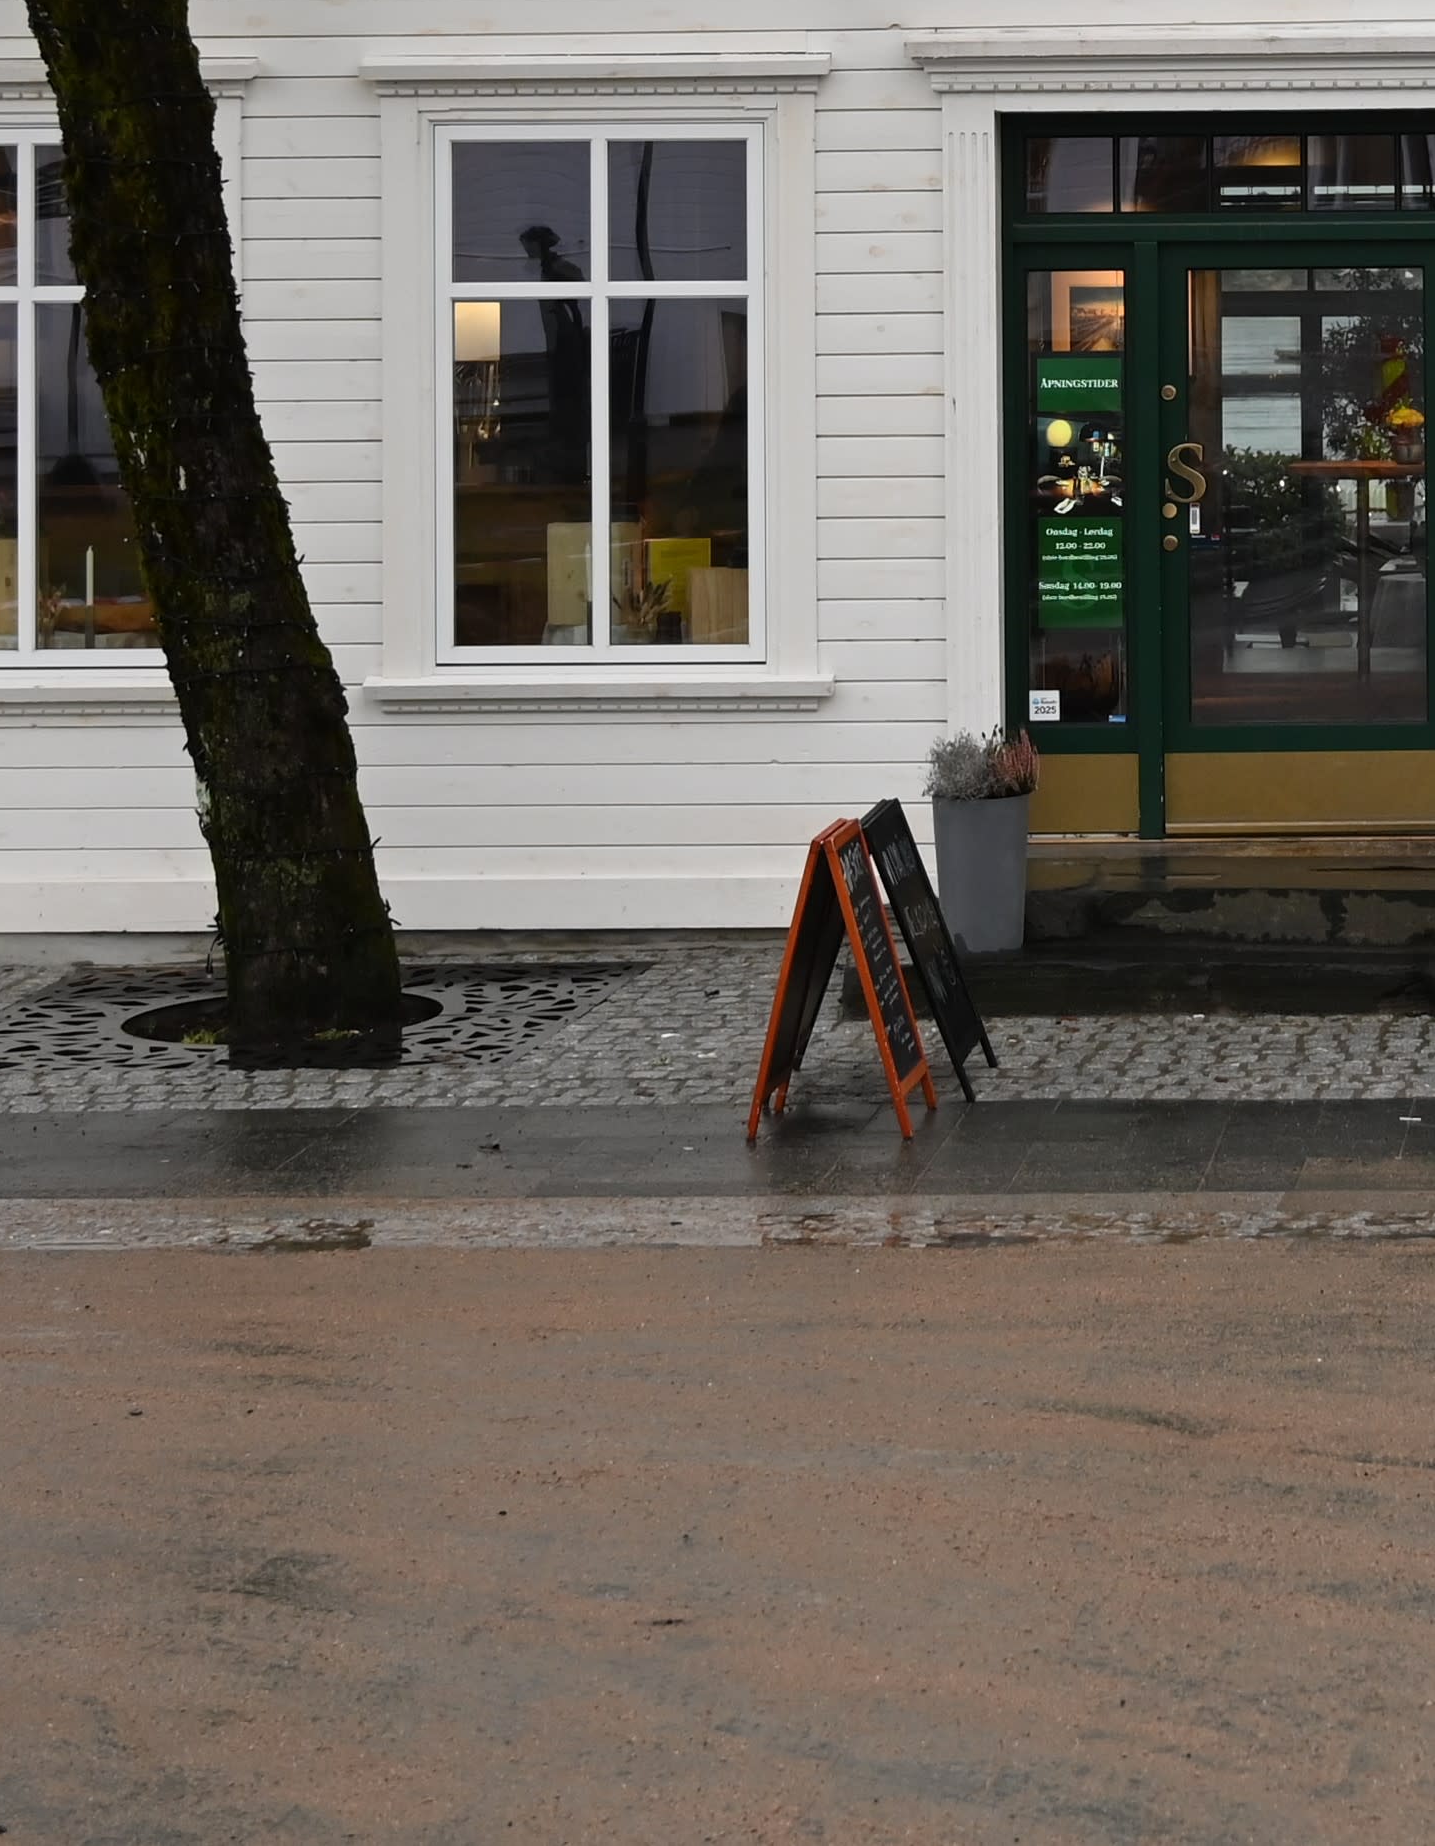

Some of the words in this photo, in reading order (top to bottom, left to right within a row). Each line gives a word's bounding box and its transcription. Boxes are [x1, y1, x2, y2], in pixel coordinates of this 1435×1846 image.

[1040, 377, 1119, 389] ÅPNINGSTIDER
[1165, 442, 1207, 504] S
[1045, 528, 1078, 538] Onsdag
[1034, 705, 1057, 715] 2025
